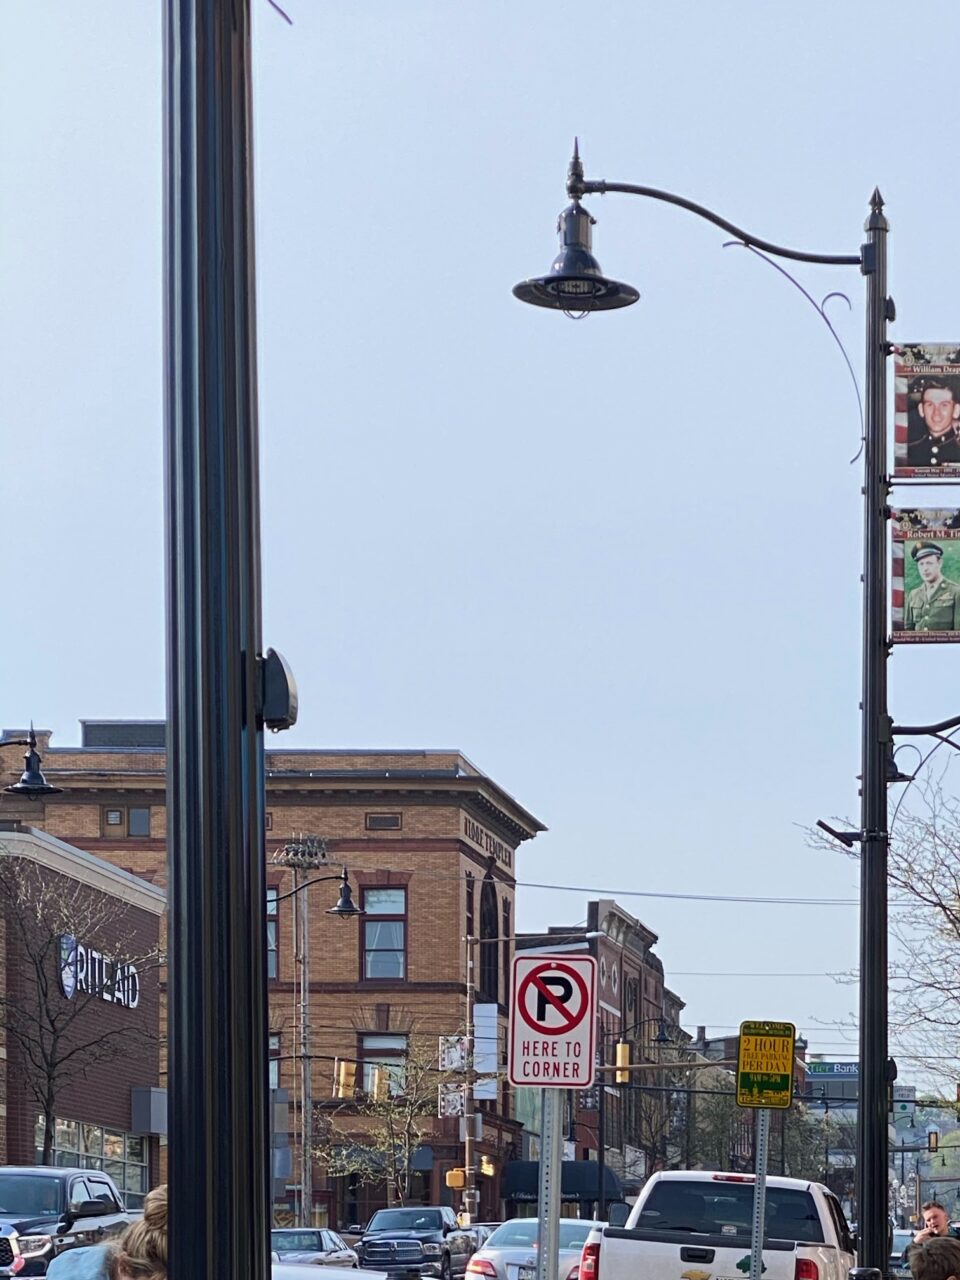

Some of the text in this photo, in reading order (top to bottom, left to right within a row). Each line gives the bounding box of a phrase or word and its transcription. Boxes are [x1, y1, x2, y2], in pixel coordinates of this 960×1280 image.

[907, 530, 934, 538] Robert
[937, 530, 947, 538] M.
[77, 944, 140, 1009] RITE AID
[749, 1022, 785, 1030] WELCOME
[522, 1041, 581, 1058] HERE TO
[743, 1037, 790, 1053] 2 HOUR
[761, 1053, 789, 1061] PARKING
[523, 1061, 580, 1078] CORNER
[742, 1060, 789, 1073] PER DAY
[833, 1063, 859, 1073] Bank
